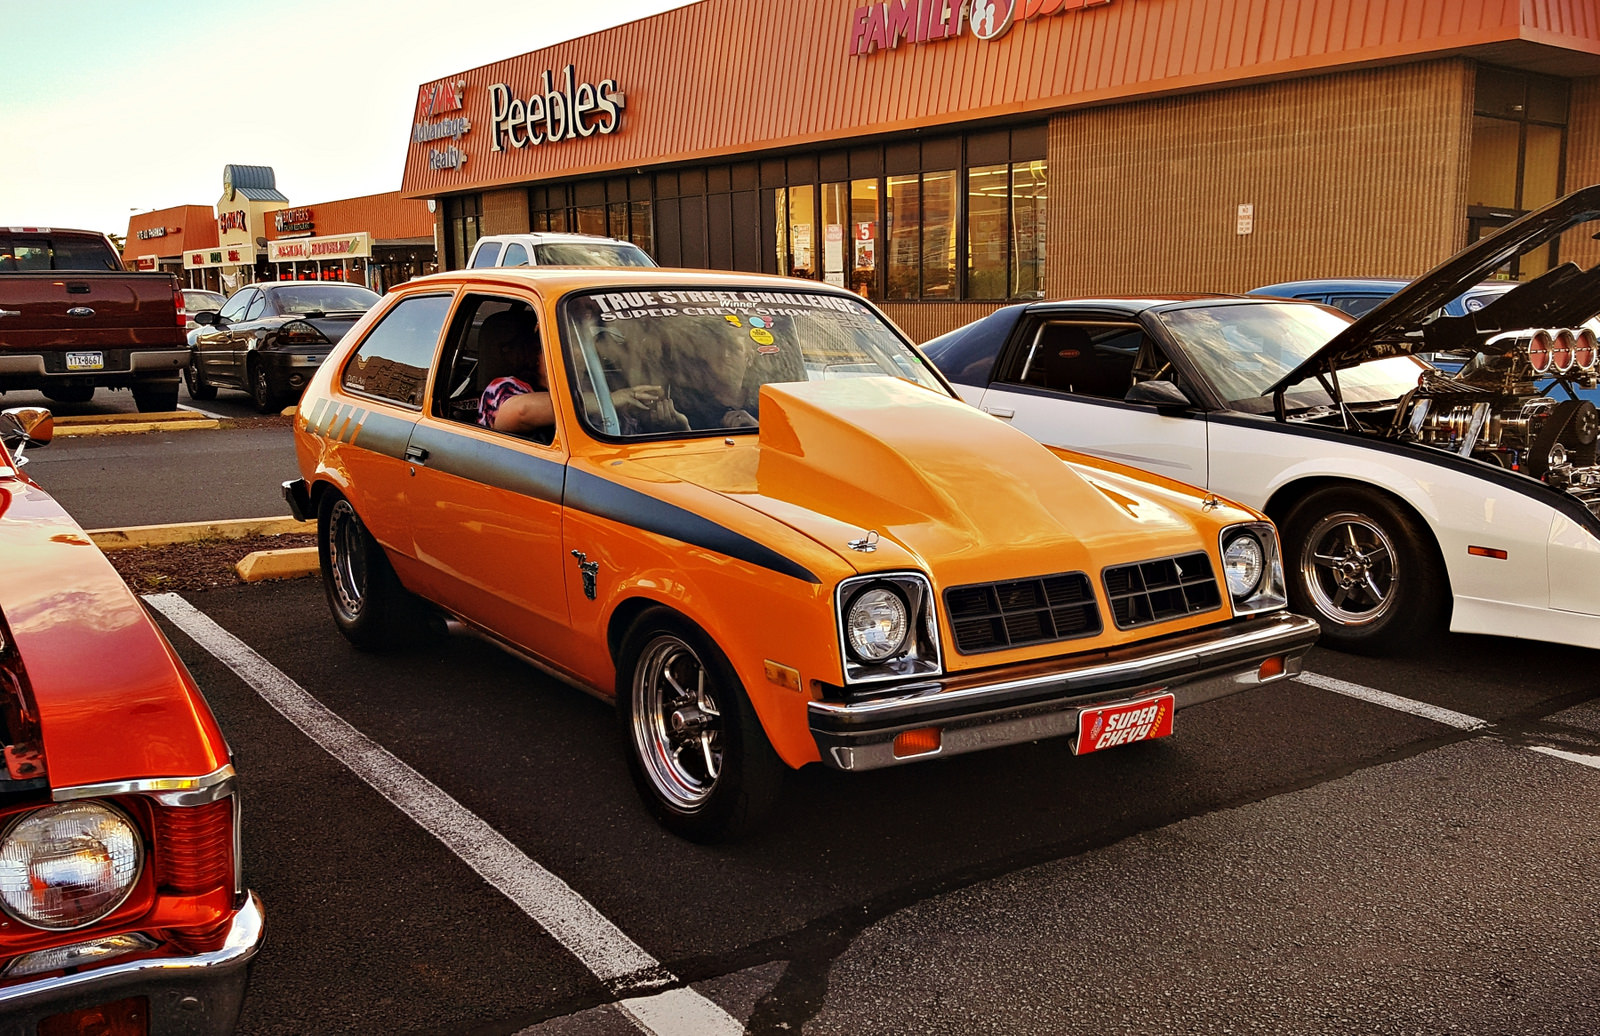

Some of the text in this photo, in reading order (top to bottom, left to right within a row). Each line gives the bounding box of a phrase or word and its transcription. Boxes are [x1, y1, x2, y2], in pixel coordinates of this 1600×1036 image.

[849, 0, 965, 56] FAMILY
[420, 82, 463, 117] RE/MAX
[488, 64, 619, 151] Peebles
[412, 117, 467, 143] Advantage
[429, 146, 463, 171] Realty
[589, 290, 861, 316] TRUE STREET CHALLENGE
[600, 306, 812, 322] SUPER CHEVY SHOW
[720, 299, 758, 309] Winner
[1105, 705, 1158, 731] SUPER
[1150, 705, 1166, 738] SHOW
[1095, 723, 1152, 749] CHEVY
